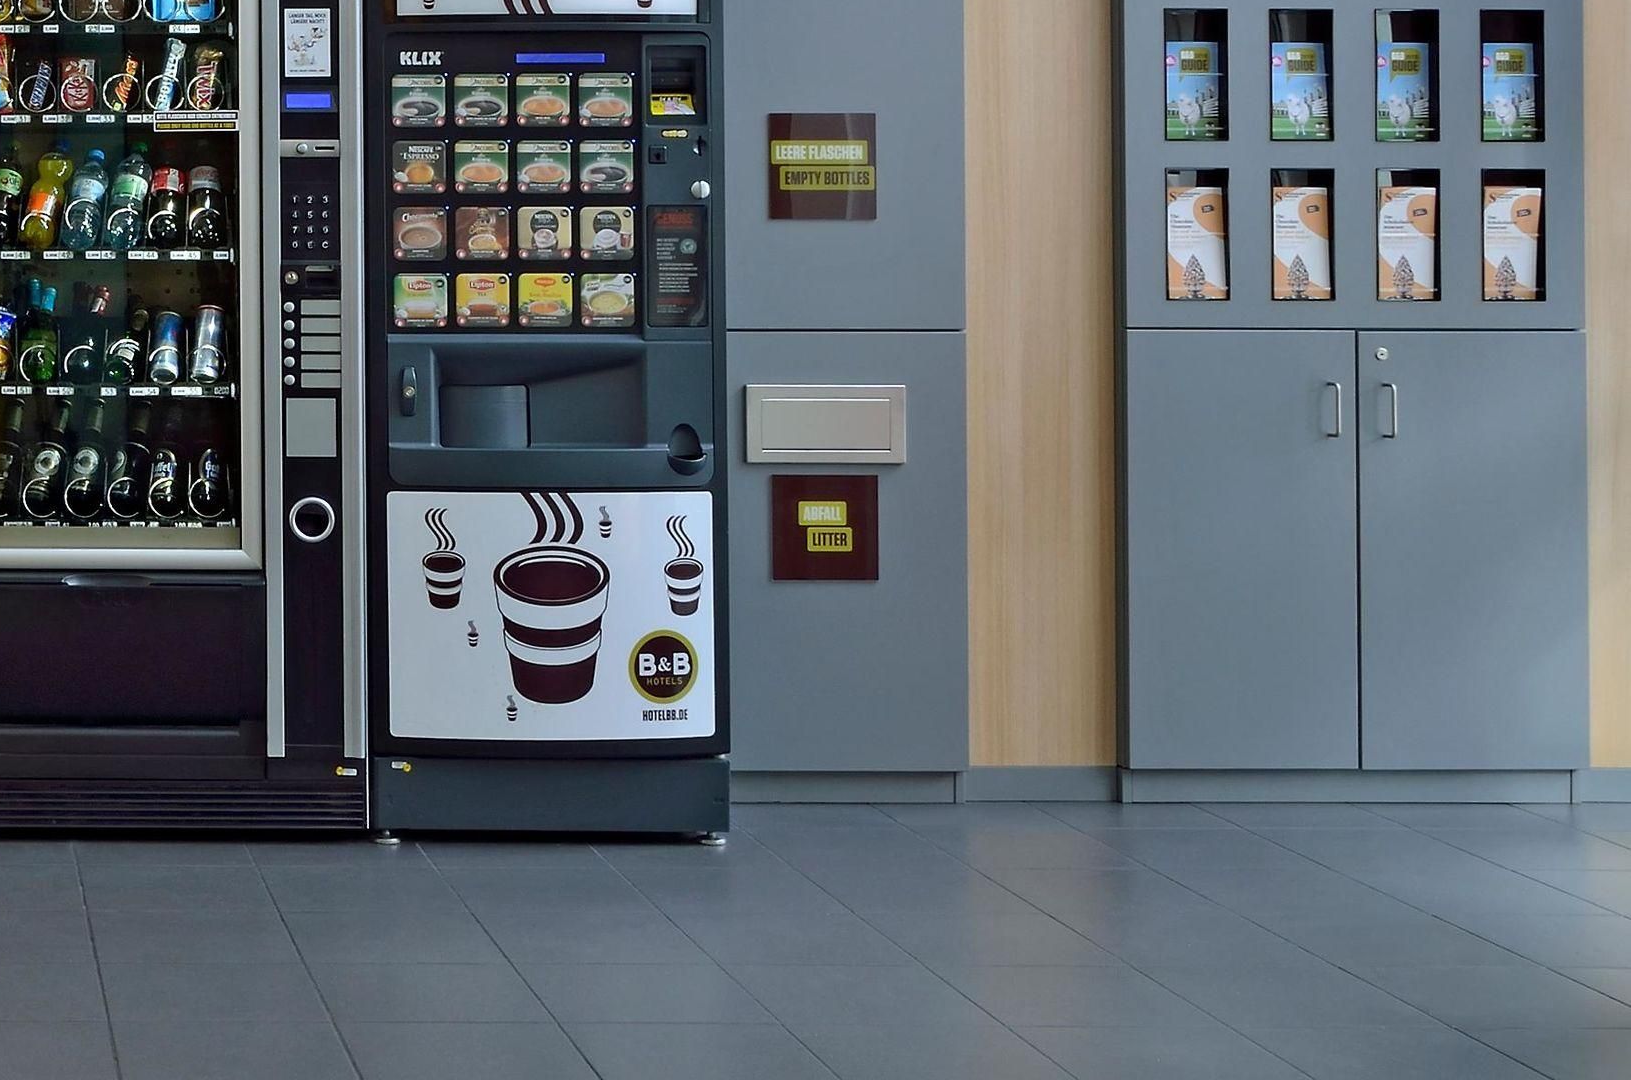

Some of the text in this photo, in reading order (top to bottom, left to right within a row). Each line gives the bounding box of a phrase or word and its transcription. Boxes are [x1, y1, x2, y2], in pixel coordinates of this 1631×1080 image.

[400, 51, 442, 65] KLIX
[775, 144, 863, 160] LEERE FLASCHEN
[784, 171, 870, 185] EMPTY BOTTLES
[409, 282, 432, 290] Lipton
[470, 281, 494, 289] Lipton
[803, 506, 842, 521] ABFALL
[812, 532, 847, 547] LITTER
[638, 652, 691, 676] B&B
[646, 676, 683, 686] HOTELS
[642, 708, 688, 722] HOTELBB.DE
